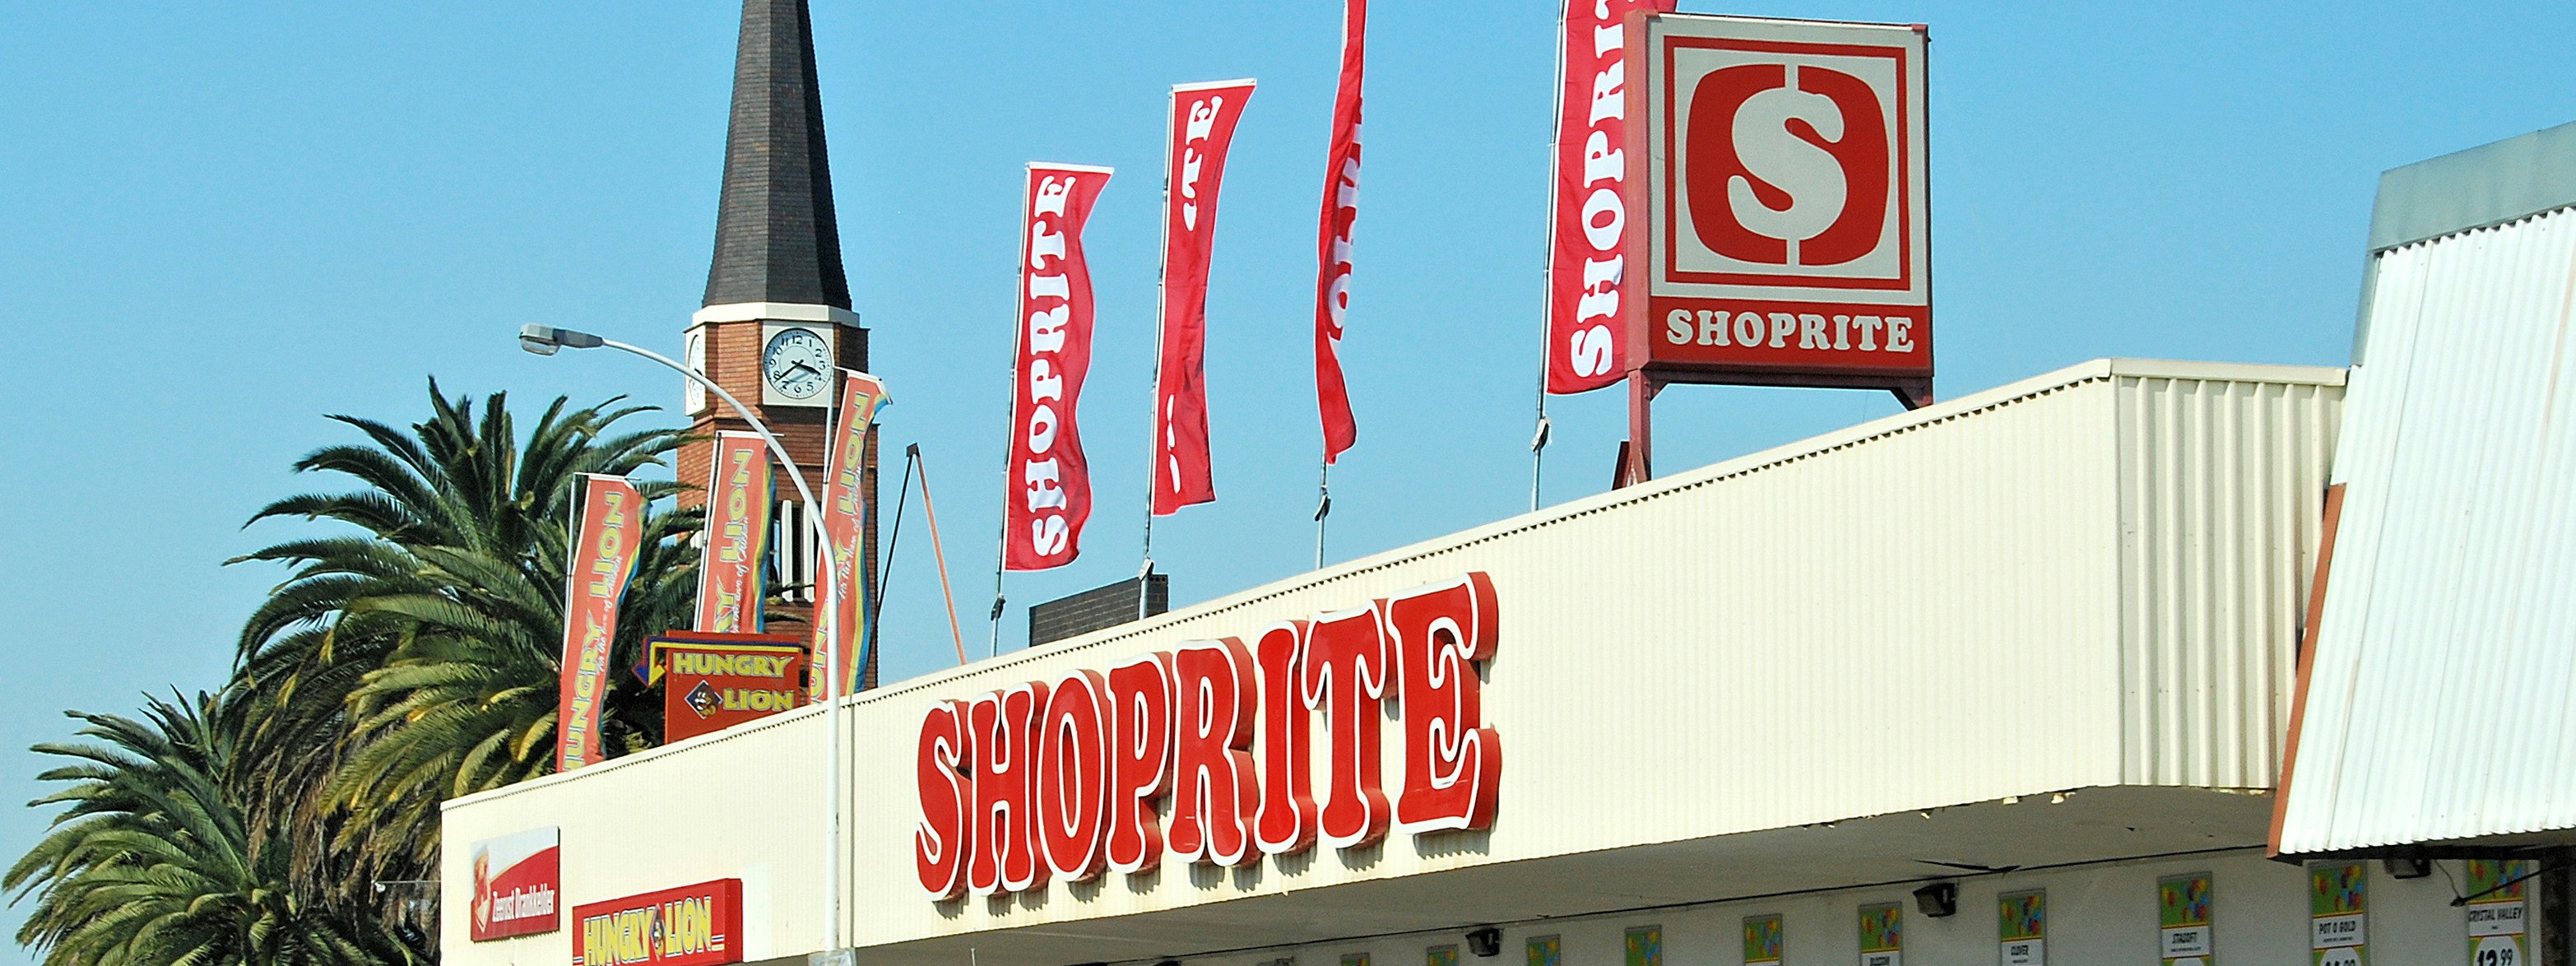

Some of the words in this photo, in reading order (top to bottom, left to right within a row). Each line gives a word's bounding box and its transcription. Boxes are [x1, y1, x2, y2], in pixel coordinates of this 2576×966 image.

[1571, 0, 1625, 378] SHOPRI
[792, 335, 802, 345] 12
[809, 338, 812, 347] 1
[1666, 308, 1915, 353] SHOPRITE
[815, 348, 822, 357] 2
[819, 360, 826, 370] 3
[1024, 174, 1076, 557] SHOPRITE
[794, 383, 801, 393] 6
[807, 381, 814, 392] 5
[838, 392, 870, 516] LION
[719, 449, 754, 563] LION
[590, 491, 624, 598] LION
[673, 652, 794, 677] HUNGRY
[722, 688, 794, 712] LION
[916, 572, 1499, 902] SHOPRITE
[583, 906, 656, 966] HUNGRY
[665, 895, 712, 958] LION
